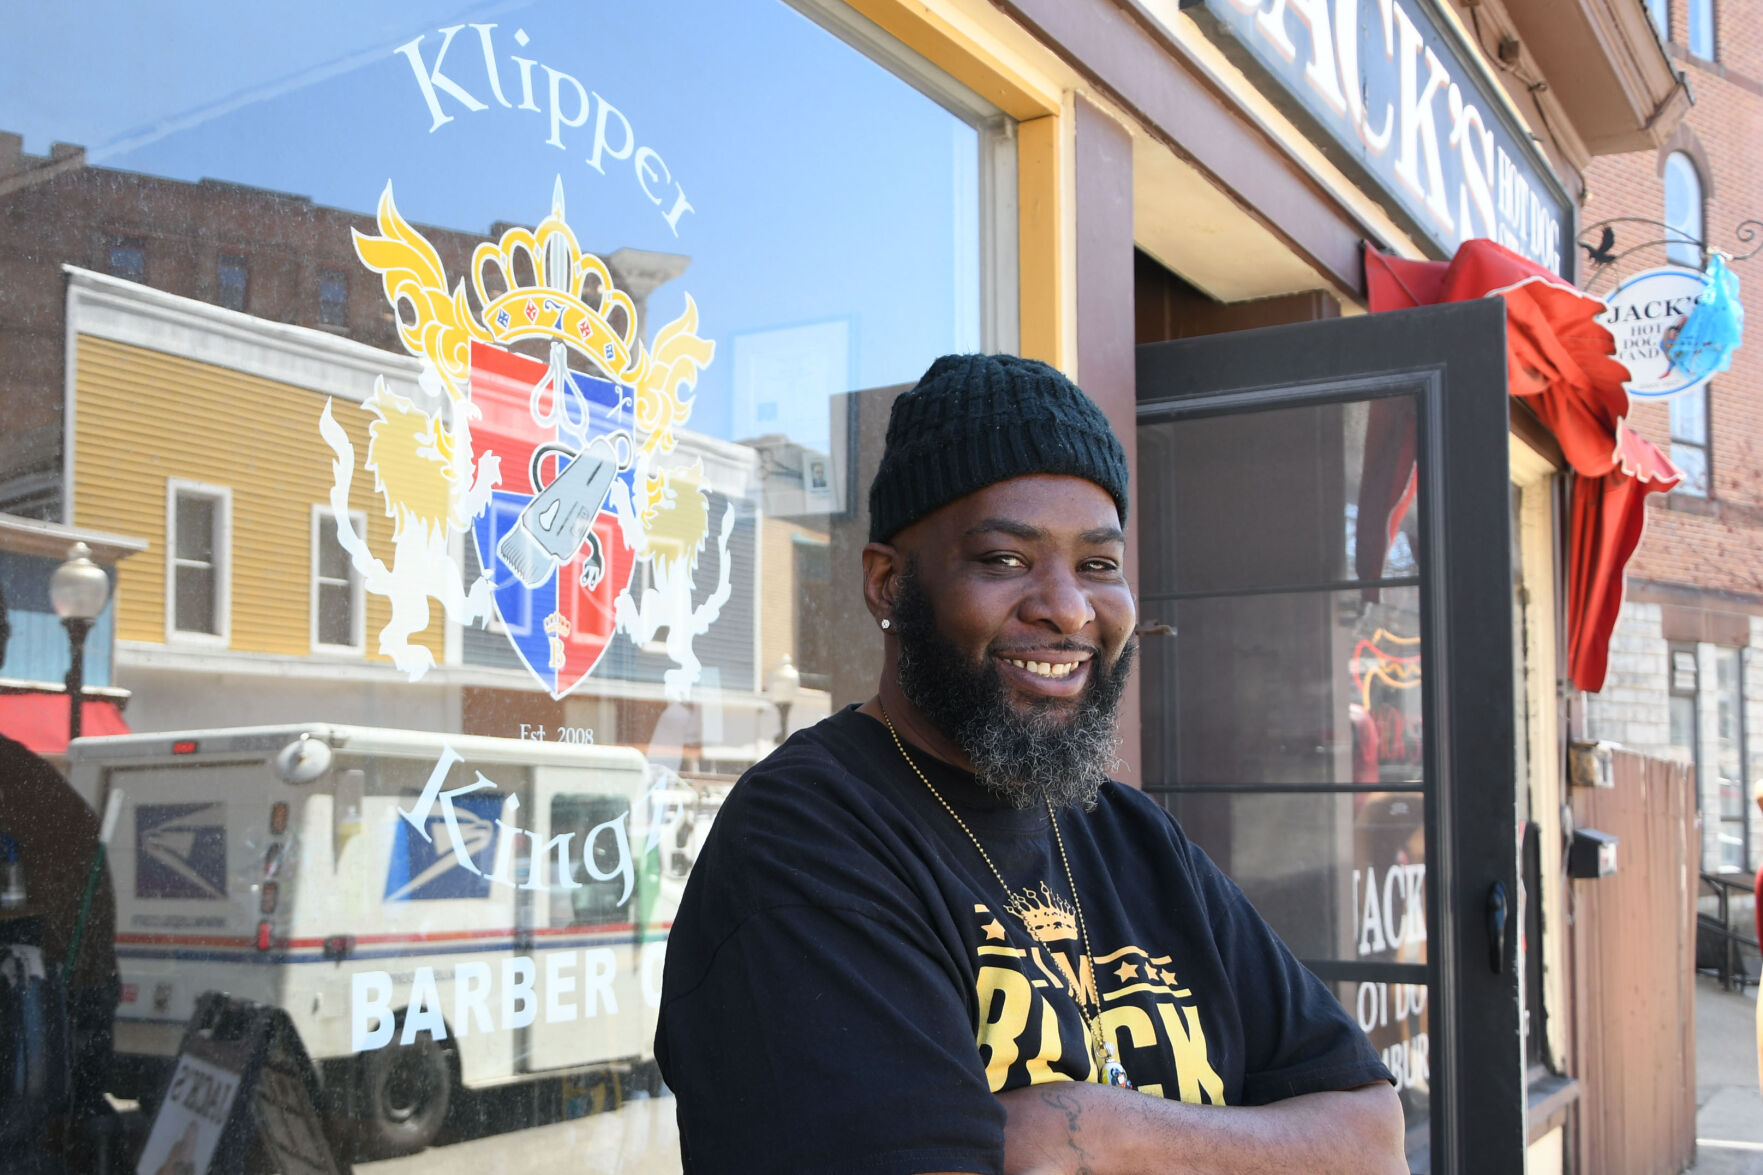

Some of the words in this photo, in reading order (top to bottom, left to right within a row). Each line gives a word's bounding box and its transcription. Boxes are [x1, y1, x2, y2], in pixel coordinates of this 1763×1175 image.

[393, 23, 695, 237] Klipper
[1229, 0, 1498, 243] ACK'S
[557, 726, 594, 745] 2008
[351, 947, 620, 1054] BARBER
[976, 965, 1227, 1107] BLCK
